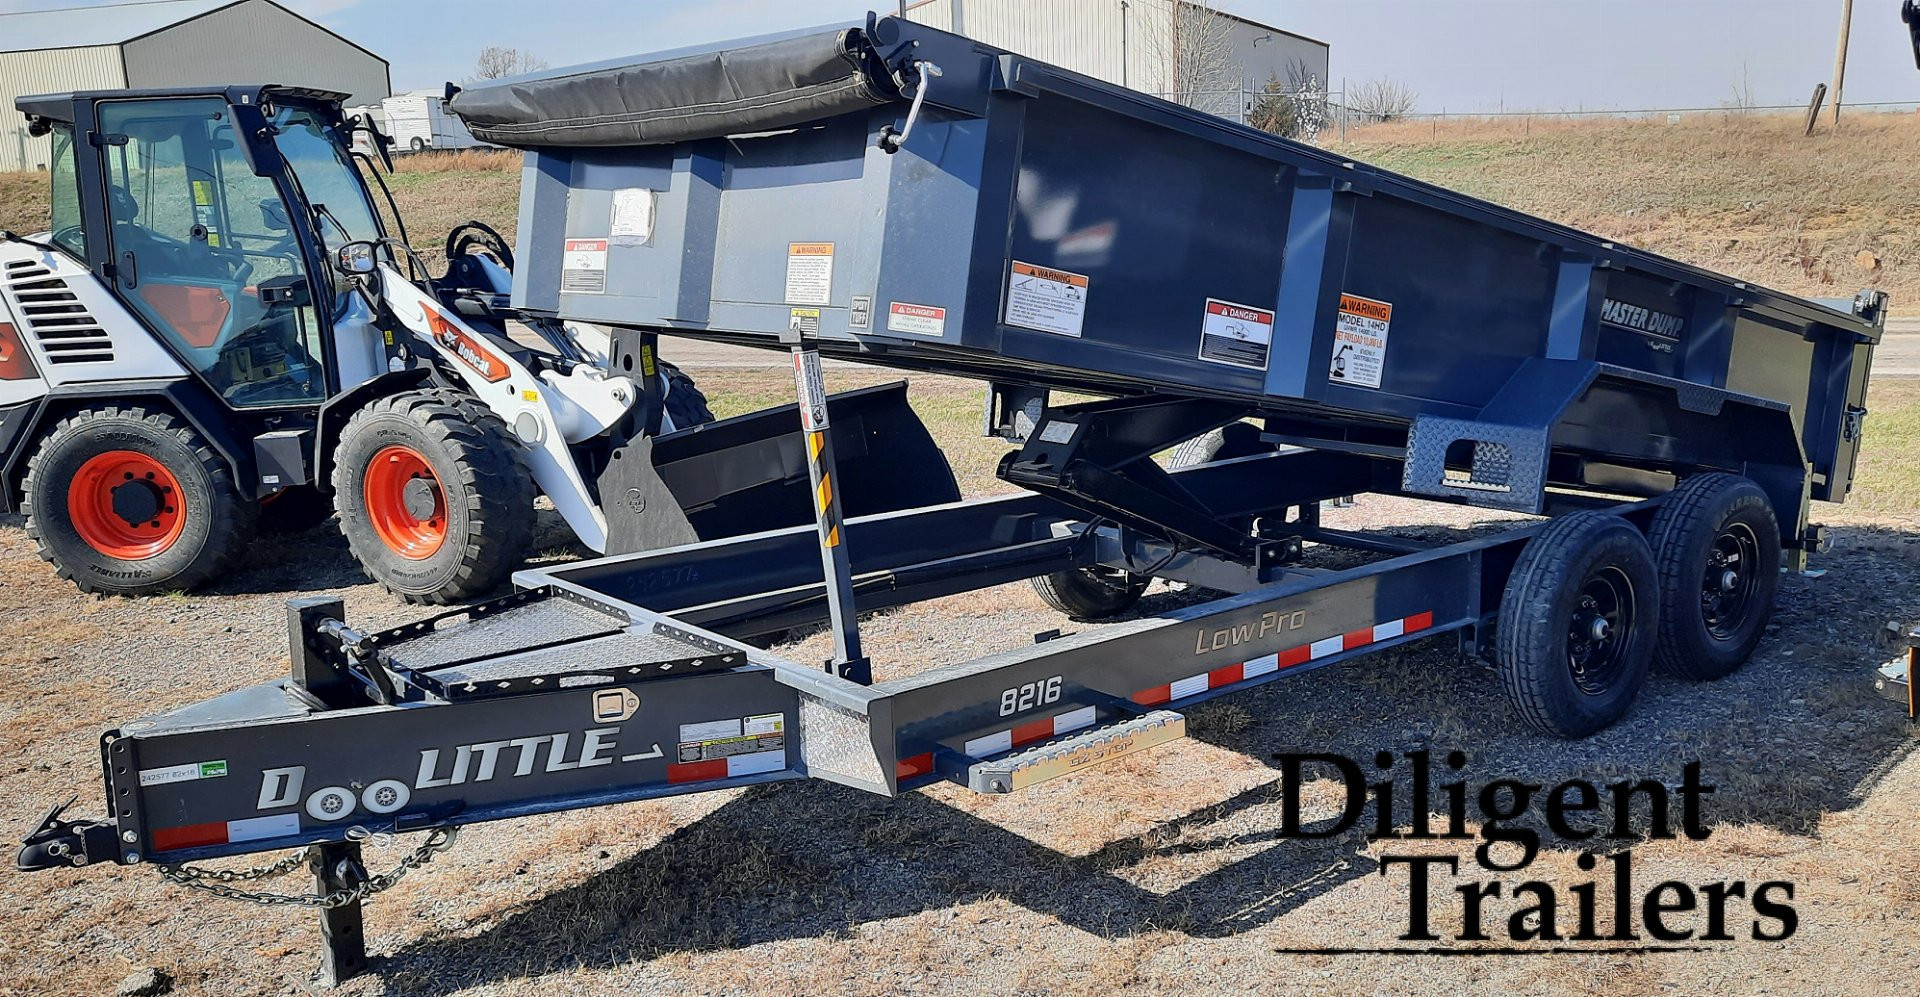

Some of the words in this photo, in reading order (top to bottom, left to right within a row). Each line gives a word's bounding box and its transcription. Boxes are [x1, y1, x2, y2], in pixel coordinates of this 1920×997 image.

[801, 246, 827, 254] WARNING
[1037, 270, 1071, 283] WARNING
[906, 307, 936, 317] DANGER
[1229, 308, 1259, 322] DANGER
[1348, 300, 1387, 318] WARNING
[1600, 298, 1649, 330] MASTER
[1647, 311, 1684, 337] DUMP
[1338, 313, 1364, 327] MODEL
[1367, 320, 1386, 332] 14HD
[458, 341, 491, 376] Bobcat
[999, 675, 1063, 717] 8216
[414, 726, 621, 790] LITTLE
[1069, 753, 1091, 767] EZ
[1093, 739, 1134, 760] STEP
